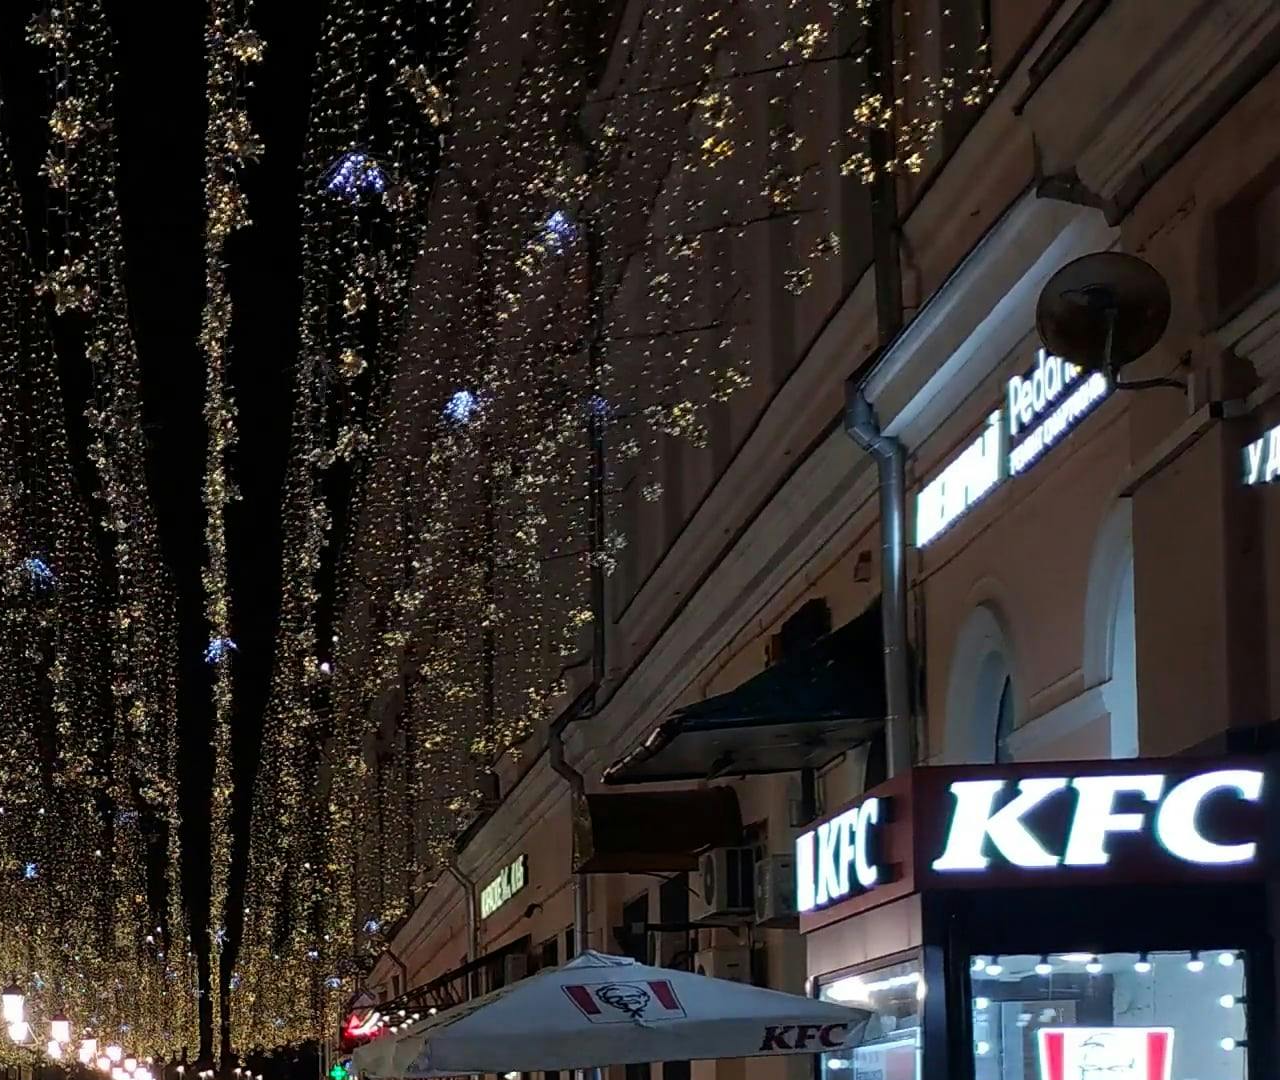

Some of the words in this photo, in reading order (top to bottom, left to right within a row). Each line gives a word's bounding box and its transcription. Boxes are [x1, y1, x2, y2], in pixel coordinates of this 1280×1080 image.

[814, 797, 882, 912] KFC
[933, 770, 1263, 873] KFC
[760, 1023, 849, 1051] KFC
